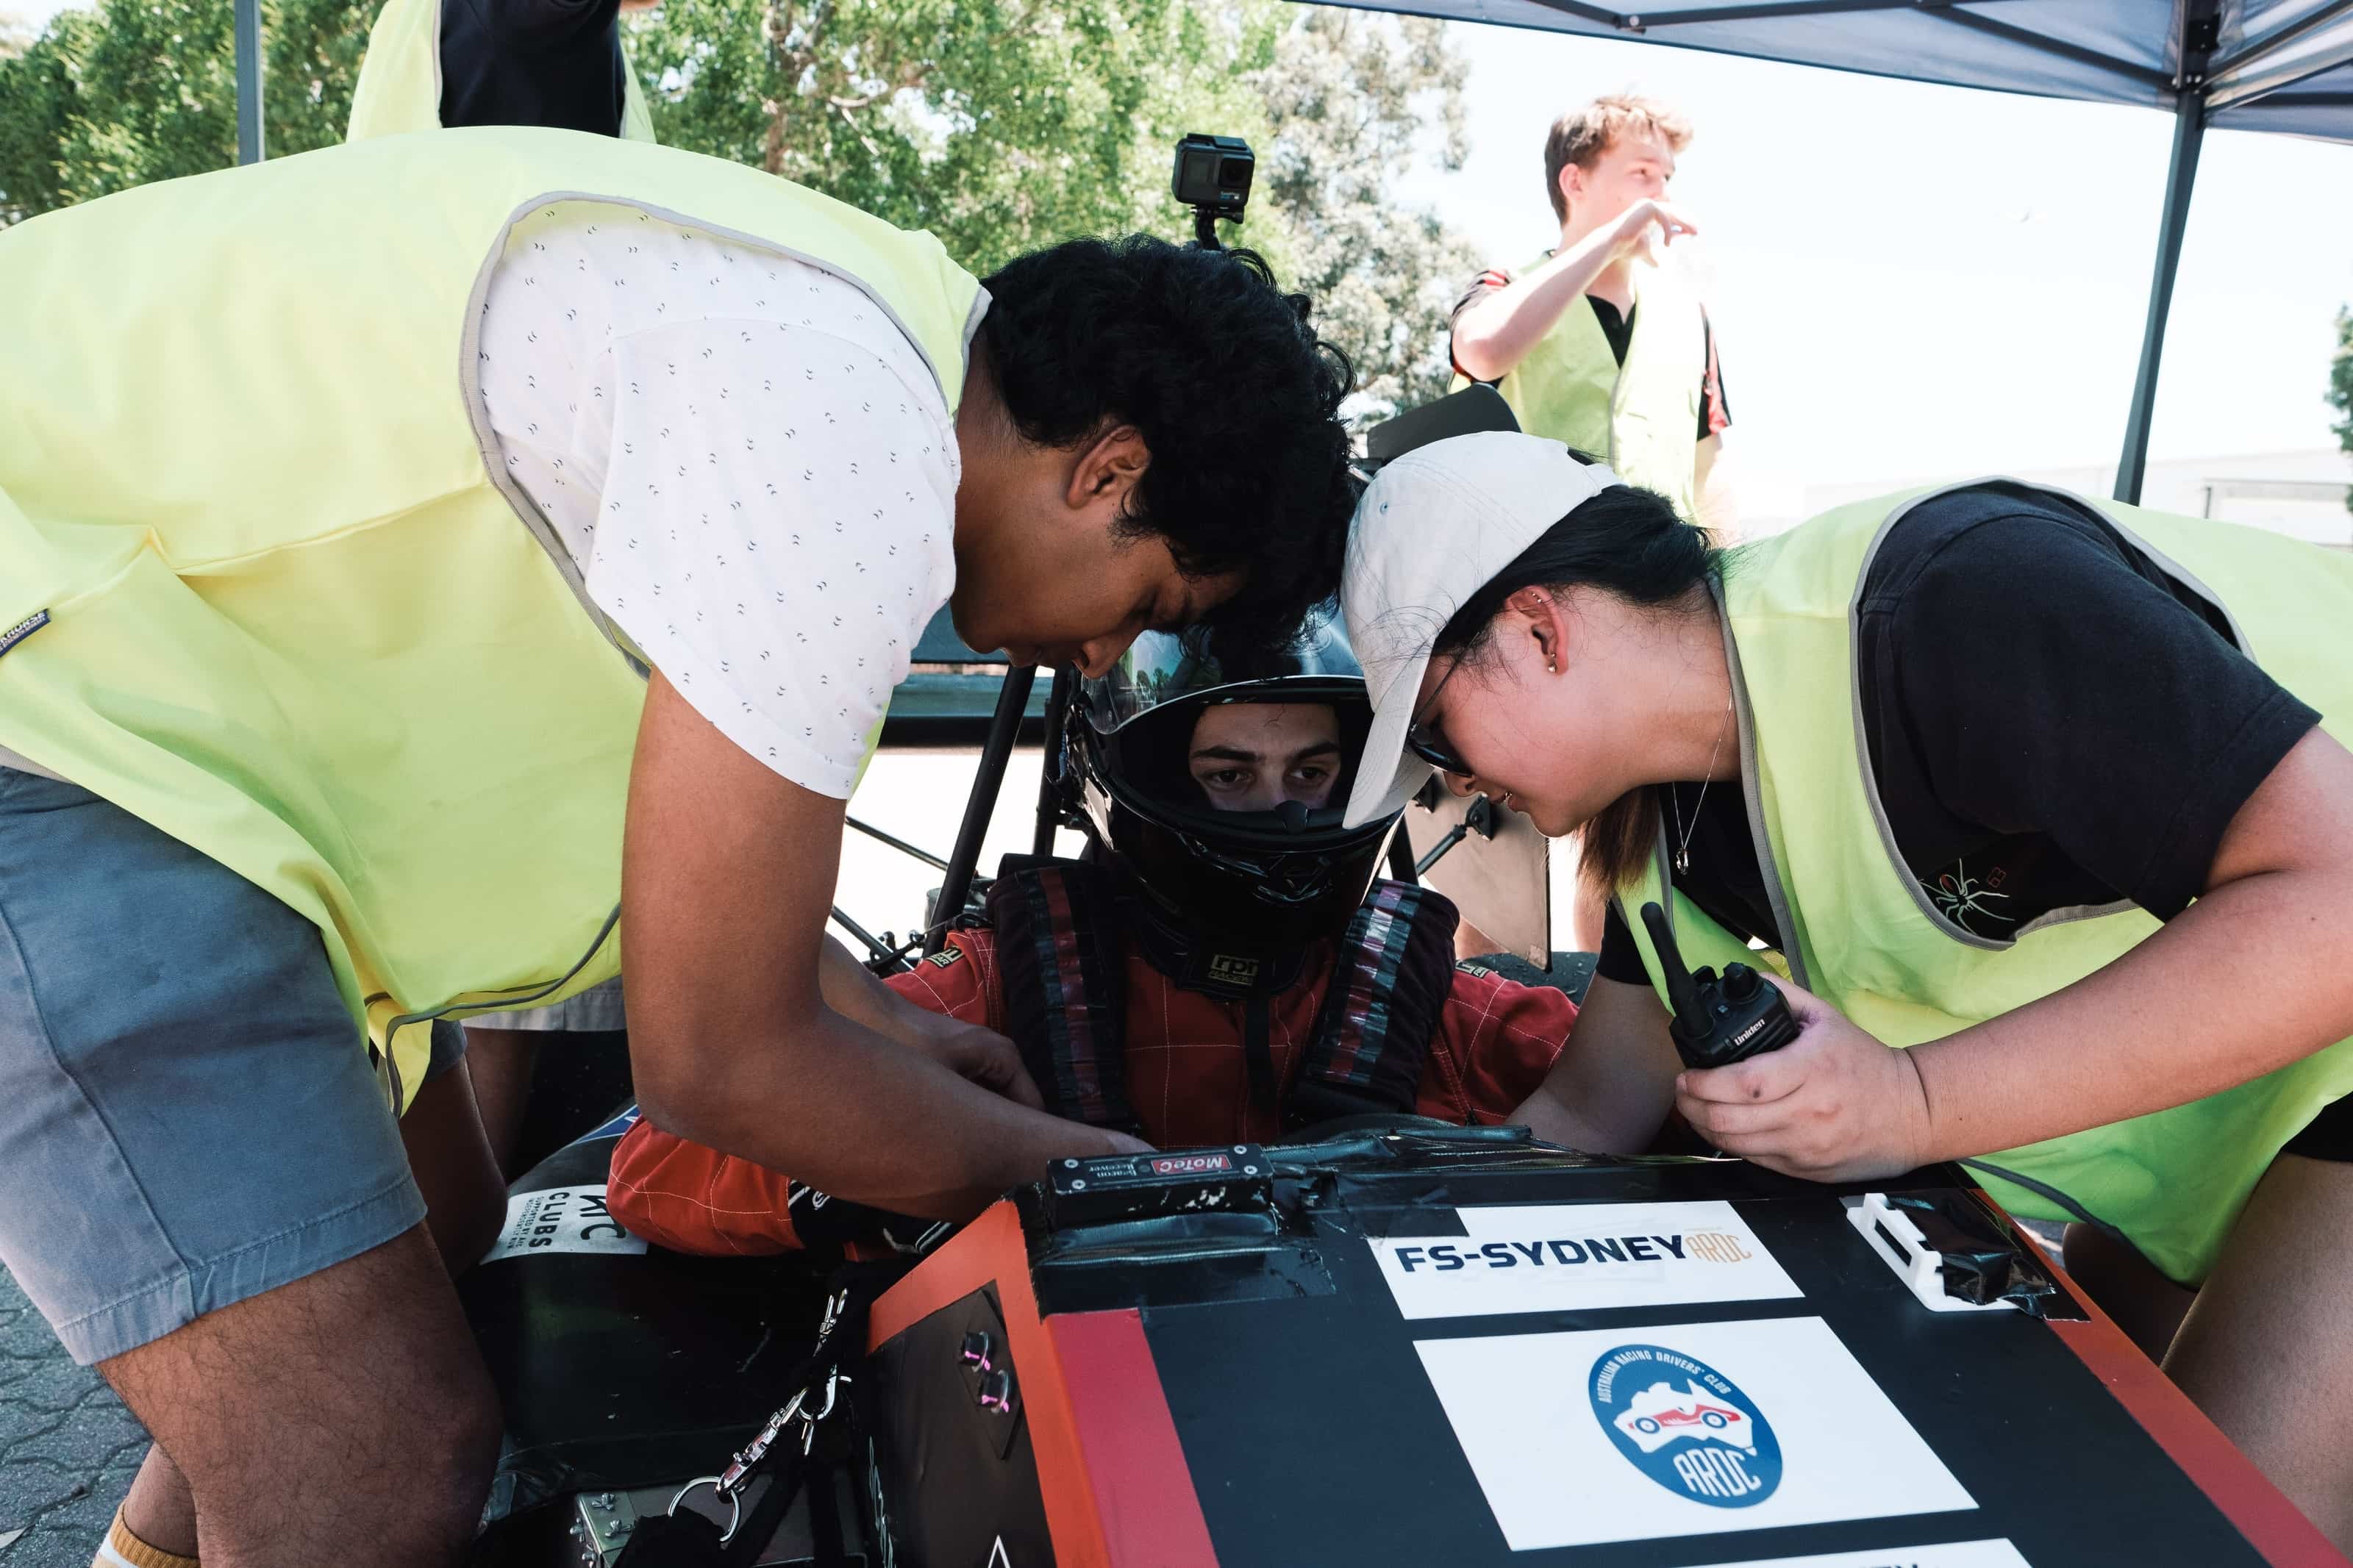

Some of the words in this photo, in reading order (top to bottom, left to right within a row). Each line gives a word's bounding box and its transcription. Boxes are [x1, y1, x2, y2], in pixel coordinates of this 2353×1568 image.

[1734, 1019, 1765, 1046] Uniden
[1159, 1157, 1223, 1173] MoTeC
[528, 1192, 570, 1247] CLUBS
[1395, 1234, 1686, 1272] FS-SYDNEY
[1685, 1233, 1752, 1263] ARDC
[1598, 1360, 1621, 1403] AUSTRALIAN
[1614, 1350, 1652, 1366] RACING
[1655, 1351, 1705, 1375] DRIVERS'
[1704, 1373, 1732, 1394] CLUB
[1673, 1447, 1762, 1497] ARDC
